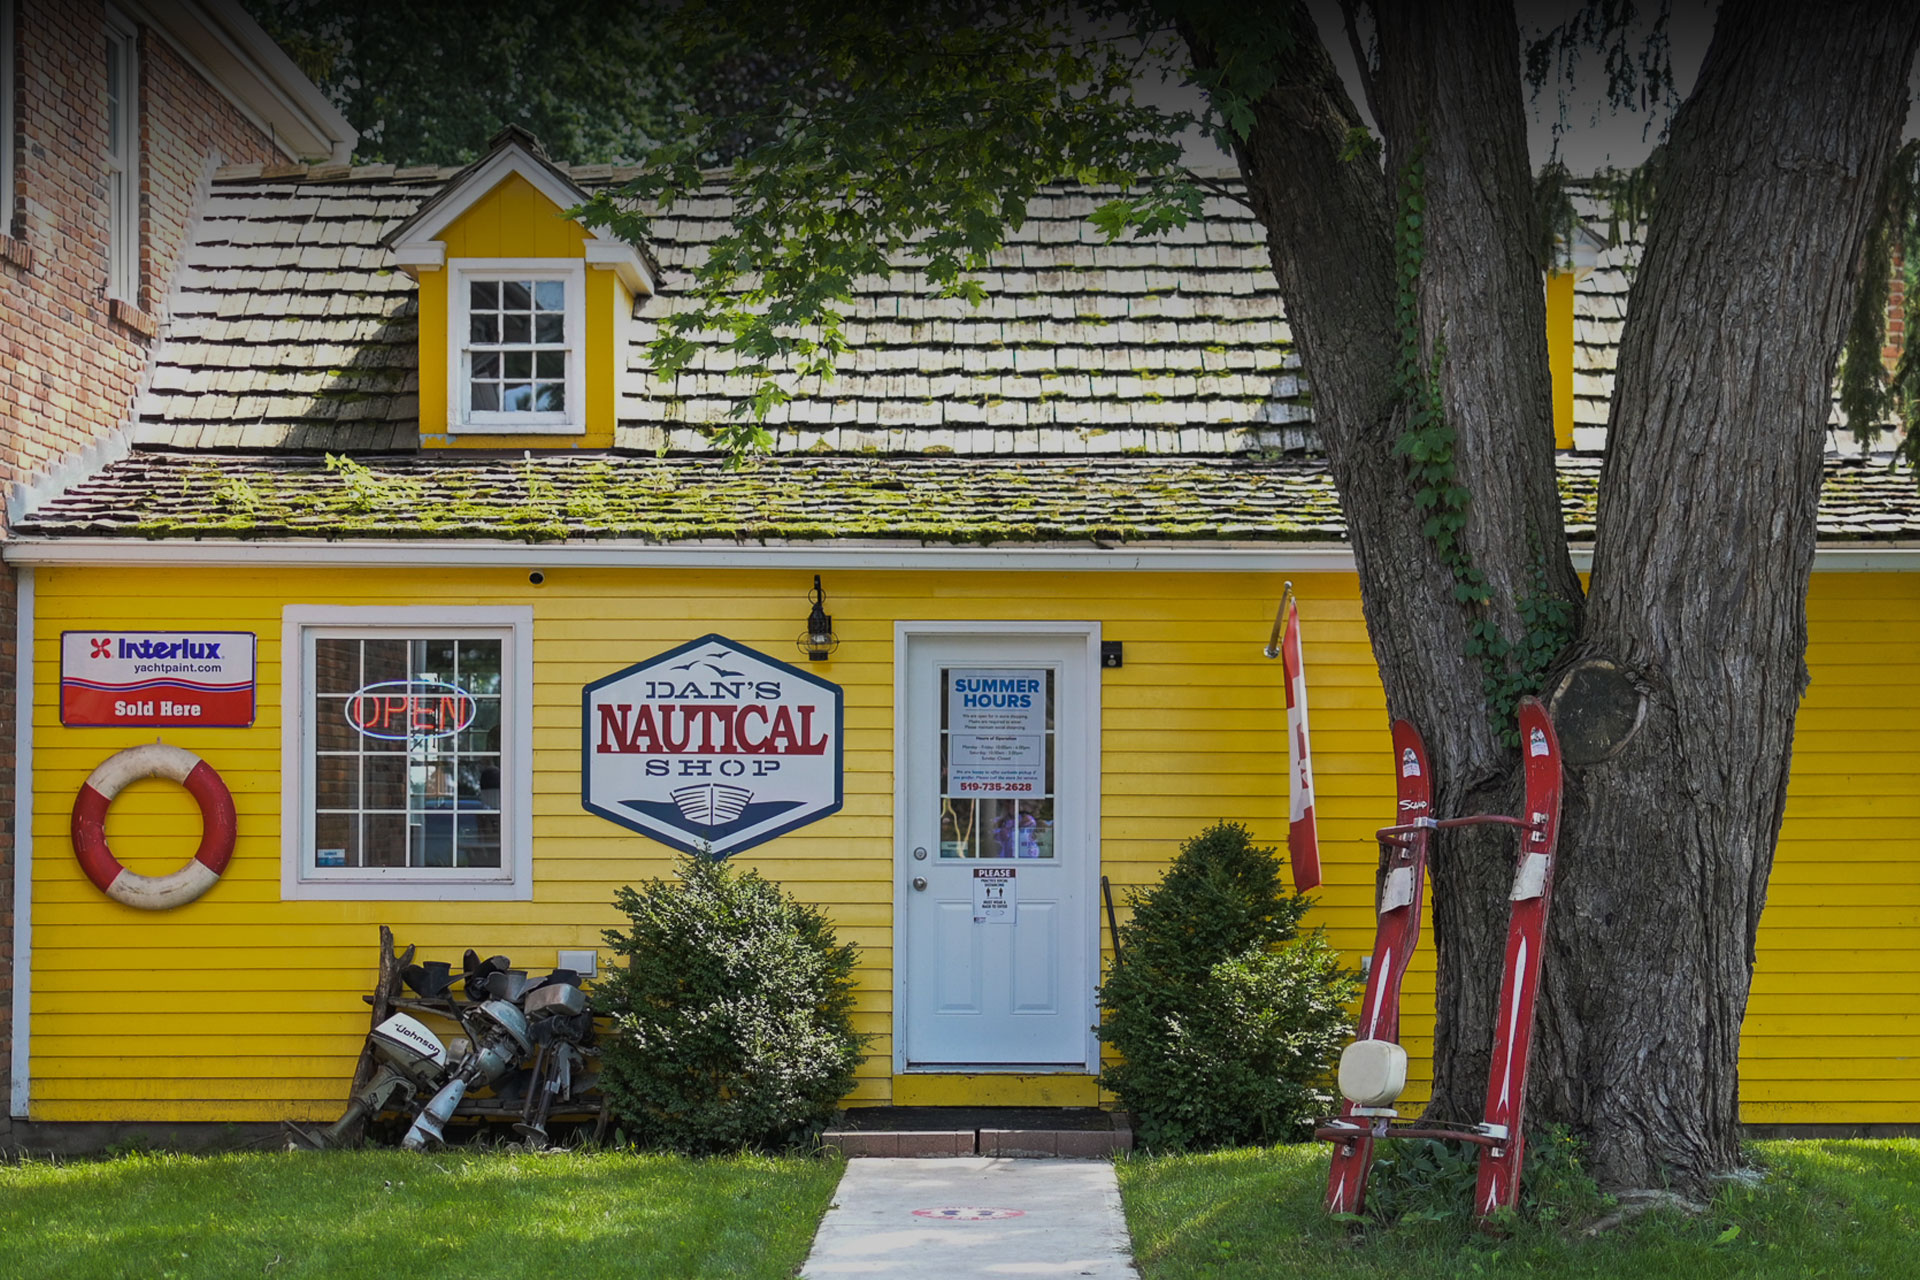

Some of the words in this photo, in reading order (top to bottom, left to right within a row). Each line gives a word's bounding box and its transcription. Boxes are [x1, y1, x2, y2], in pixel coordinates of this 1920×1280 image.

[118, 638, 221, 659] Interlux
[134, 663, 222, 674] yachtpaint.com
[645, 681, 782, 700] DAN'S
[955, 679, 1040, 693] SUMMER
[114, 701, 154, 717] Sold
[160, 701, 201, 717] Here
[963, 694, 1032, 708] HOURS
[353, 694, 467, 729] OPEN
[596, 704, 829, 756] NAUTICAL
[645, 759, 781, 777] SHOP
[960, 782, 1032, 791] 519-735-2628
[396, 1024, 441, 1053] Johnson
